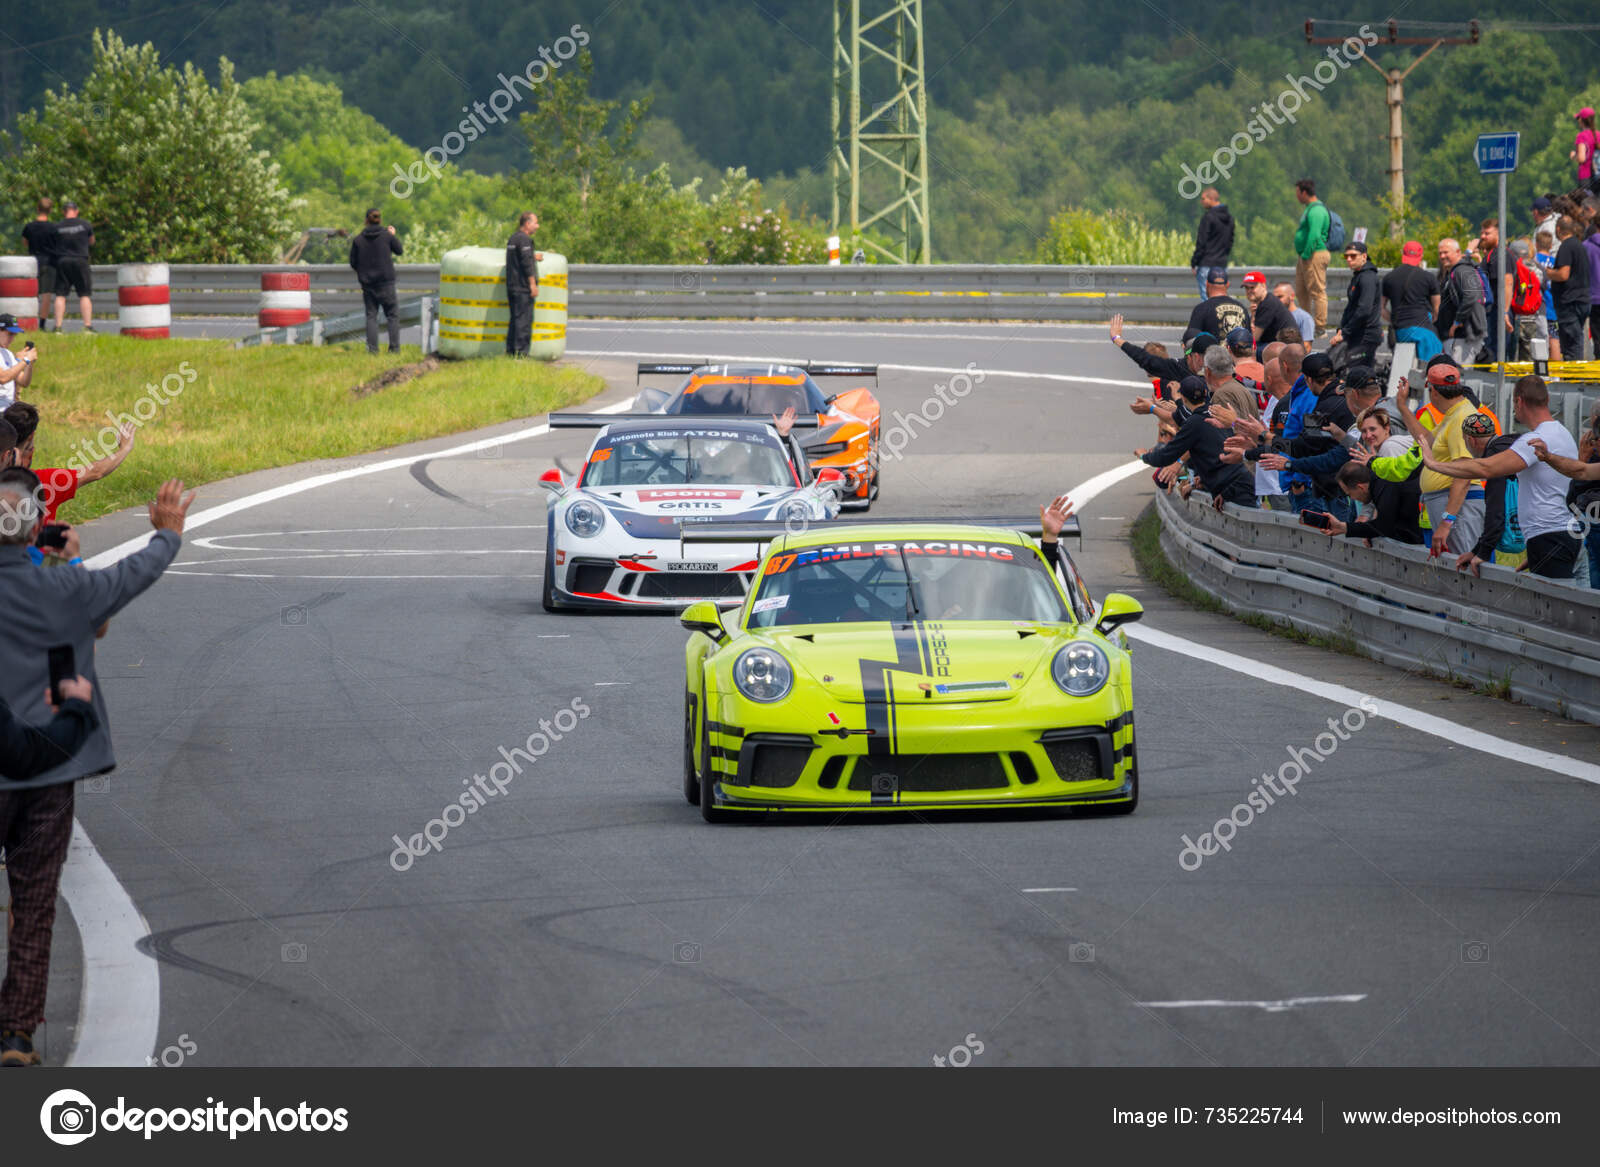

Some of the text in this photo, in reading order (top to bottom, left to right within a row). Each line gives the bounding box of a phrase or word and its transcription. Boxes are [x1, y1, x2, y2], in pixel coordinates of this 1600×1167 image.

[682, 430, 739, 438] ATOM
[764, 554, 799, 576] 87
[928, 623, 952, 677] PORSCHE
